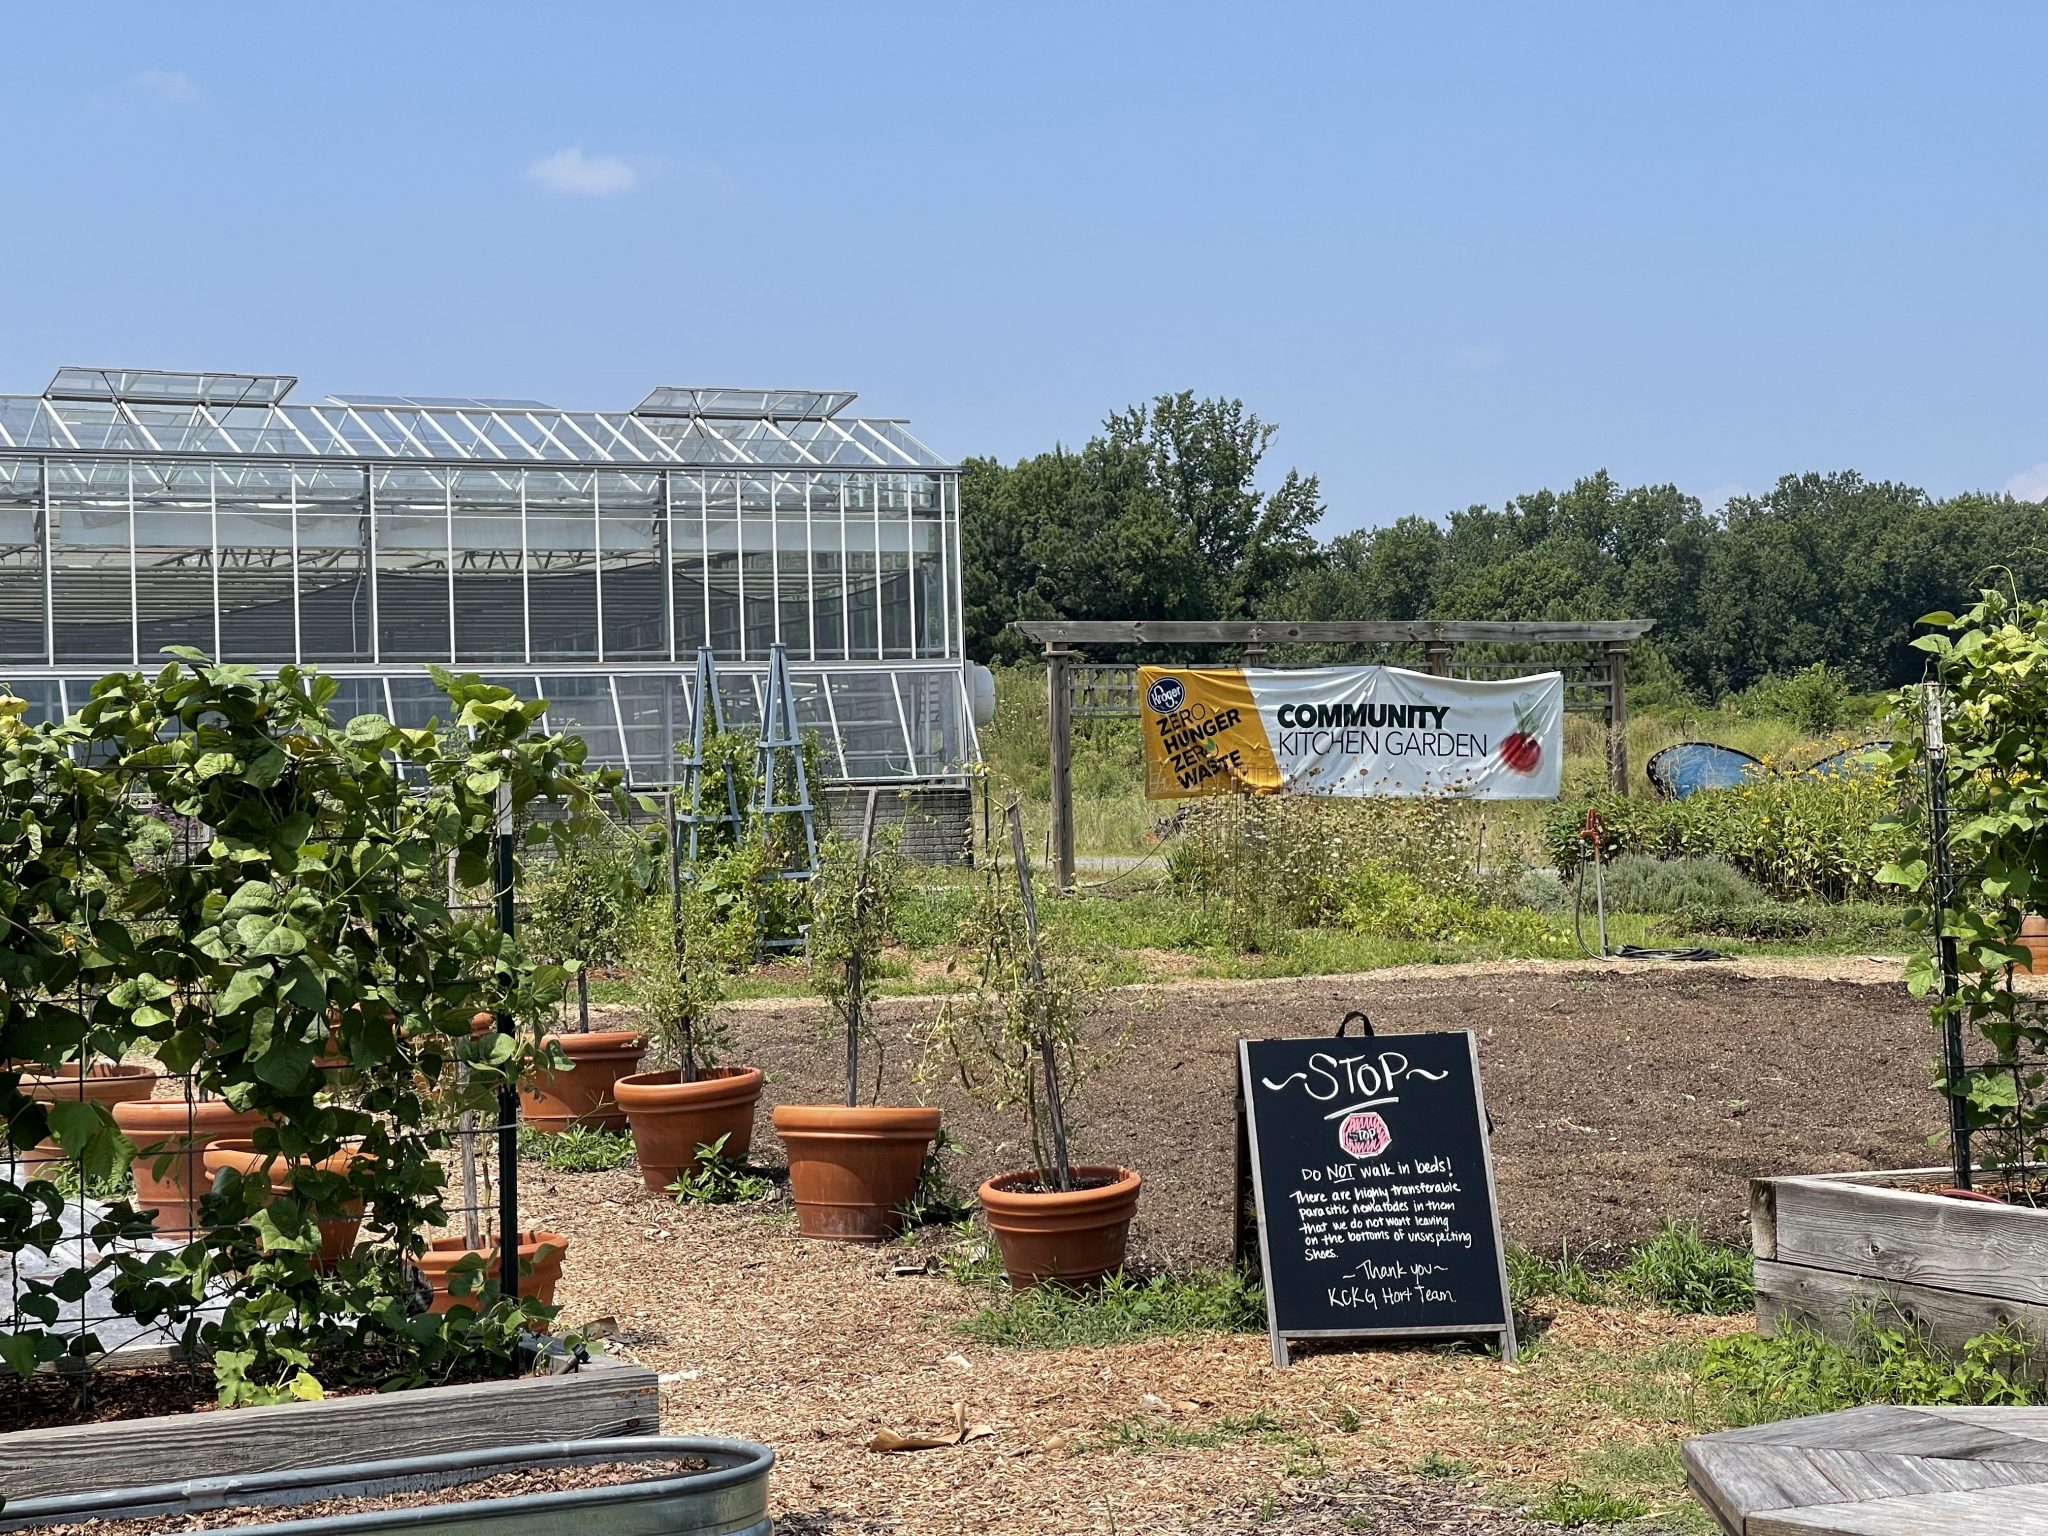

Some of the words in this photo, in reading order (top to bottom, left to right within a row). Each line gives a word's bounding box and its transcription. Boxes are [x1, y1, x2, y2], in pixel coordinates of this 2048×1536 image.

[1151, 686, 1181, 708] Kroger
[1156, 703, 1206, 737] ZERO
[1277, 703, 1450, 729] COMMUNITY
[1163, 709, 1242, 755] HUNGER
[1279, 730, 1379, 756] KITCHEN
[1385, 731, 1487, 758] GARDEN
[1177, 750, 1244, 789] WASTE
[1326, 1163, 1357, 1182] NOT
[1360, 1163, 1395, 1178] walk
[1397, 1161, 1411, 1175] in
[1414, 1156, 1453, 1178] beds!
[1289, 1190, 1328, 1204] There
[1331, 1190, 1352, 1202] are
[1354, 1186, 1389, 1204] highly
[1391, 1181, 1461, 1196] transferable
[1298, 1204, 1349, 1221] parasitic
[1352, 1200, 1409, 1214] nematodes
[1413, 1200, 1425, 1212] in
[1424, 1200, 1455, 1212] them
[1298, 1222, 1328, 1234] that
[1332, 1220, 1348, 1230] we
[1350, 1217, 1363, 1229] do
[1365, 1216, 1384, 1229] not
[1385, 1215, 1411, 1227] want
[1414, 1214, 1449, 1231] leaving
[1304, 1236, 1319, 1246] on
[1320, 1232, 1345, 1246] the
[1347, 1230, 1390, 1242] bottoms
[1393, 1229, 1406, 1242] of
[1407, 1230, 1472, 1249] unsuspecting
[1327, 1286, 1378, 1311] KCKG
[1381, 1286, 1413, 1305] Hort
